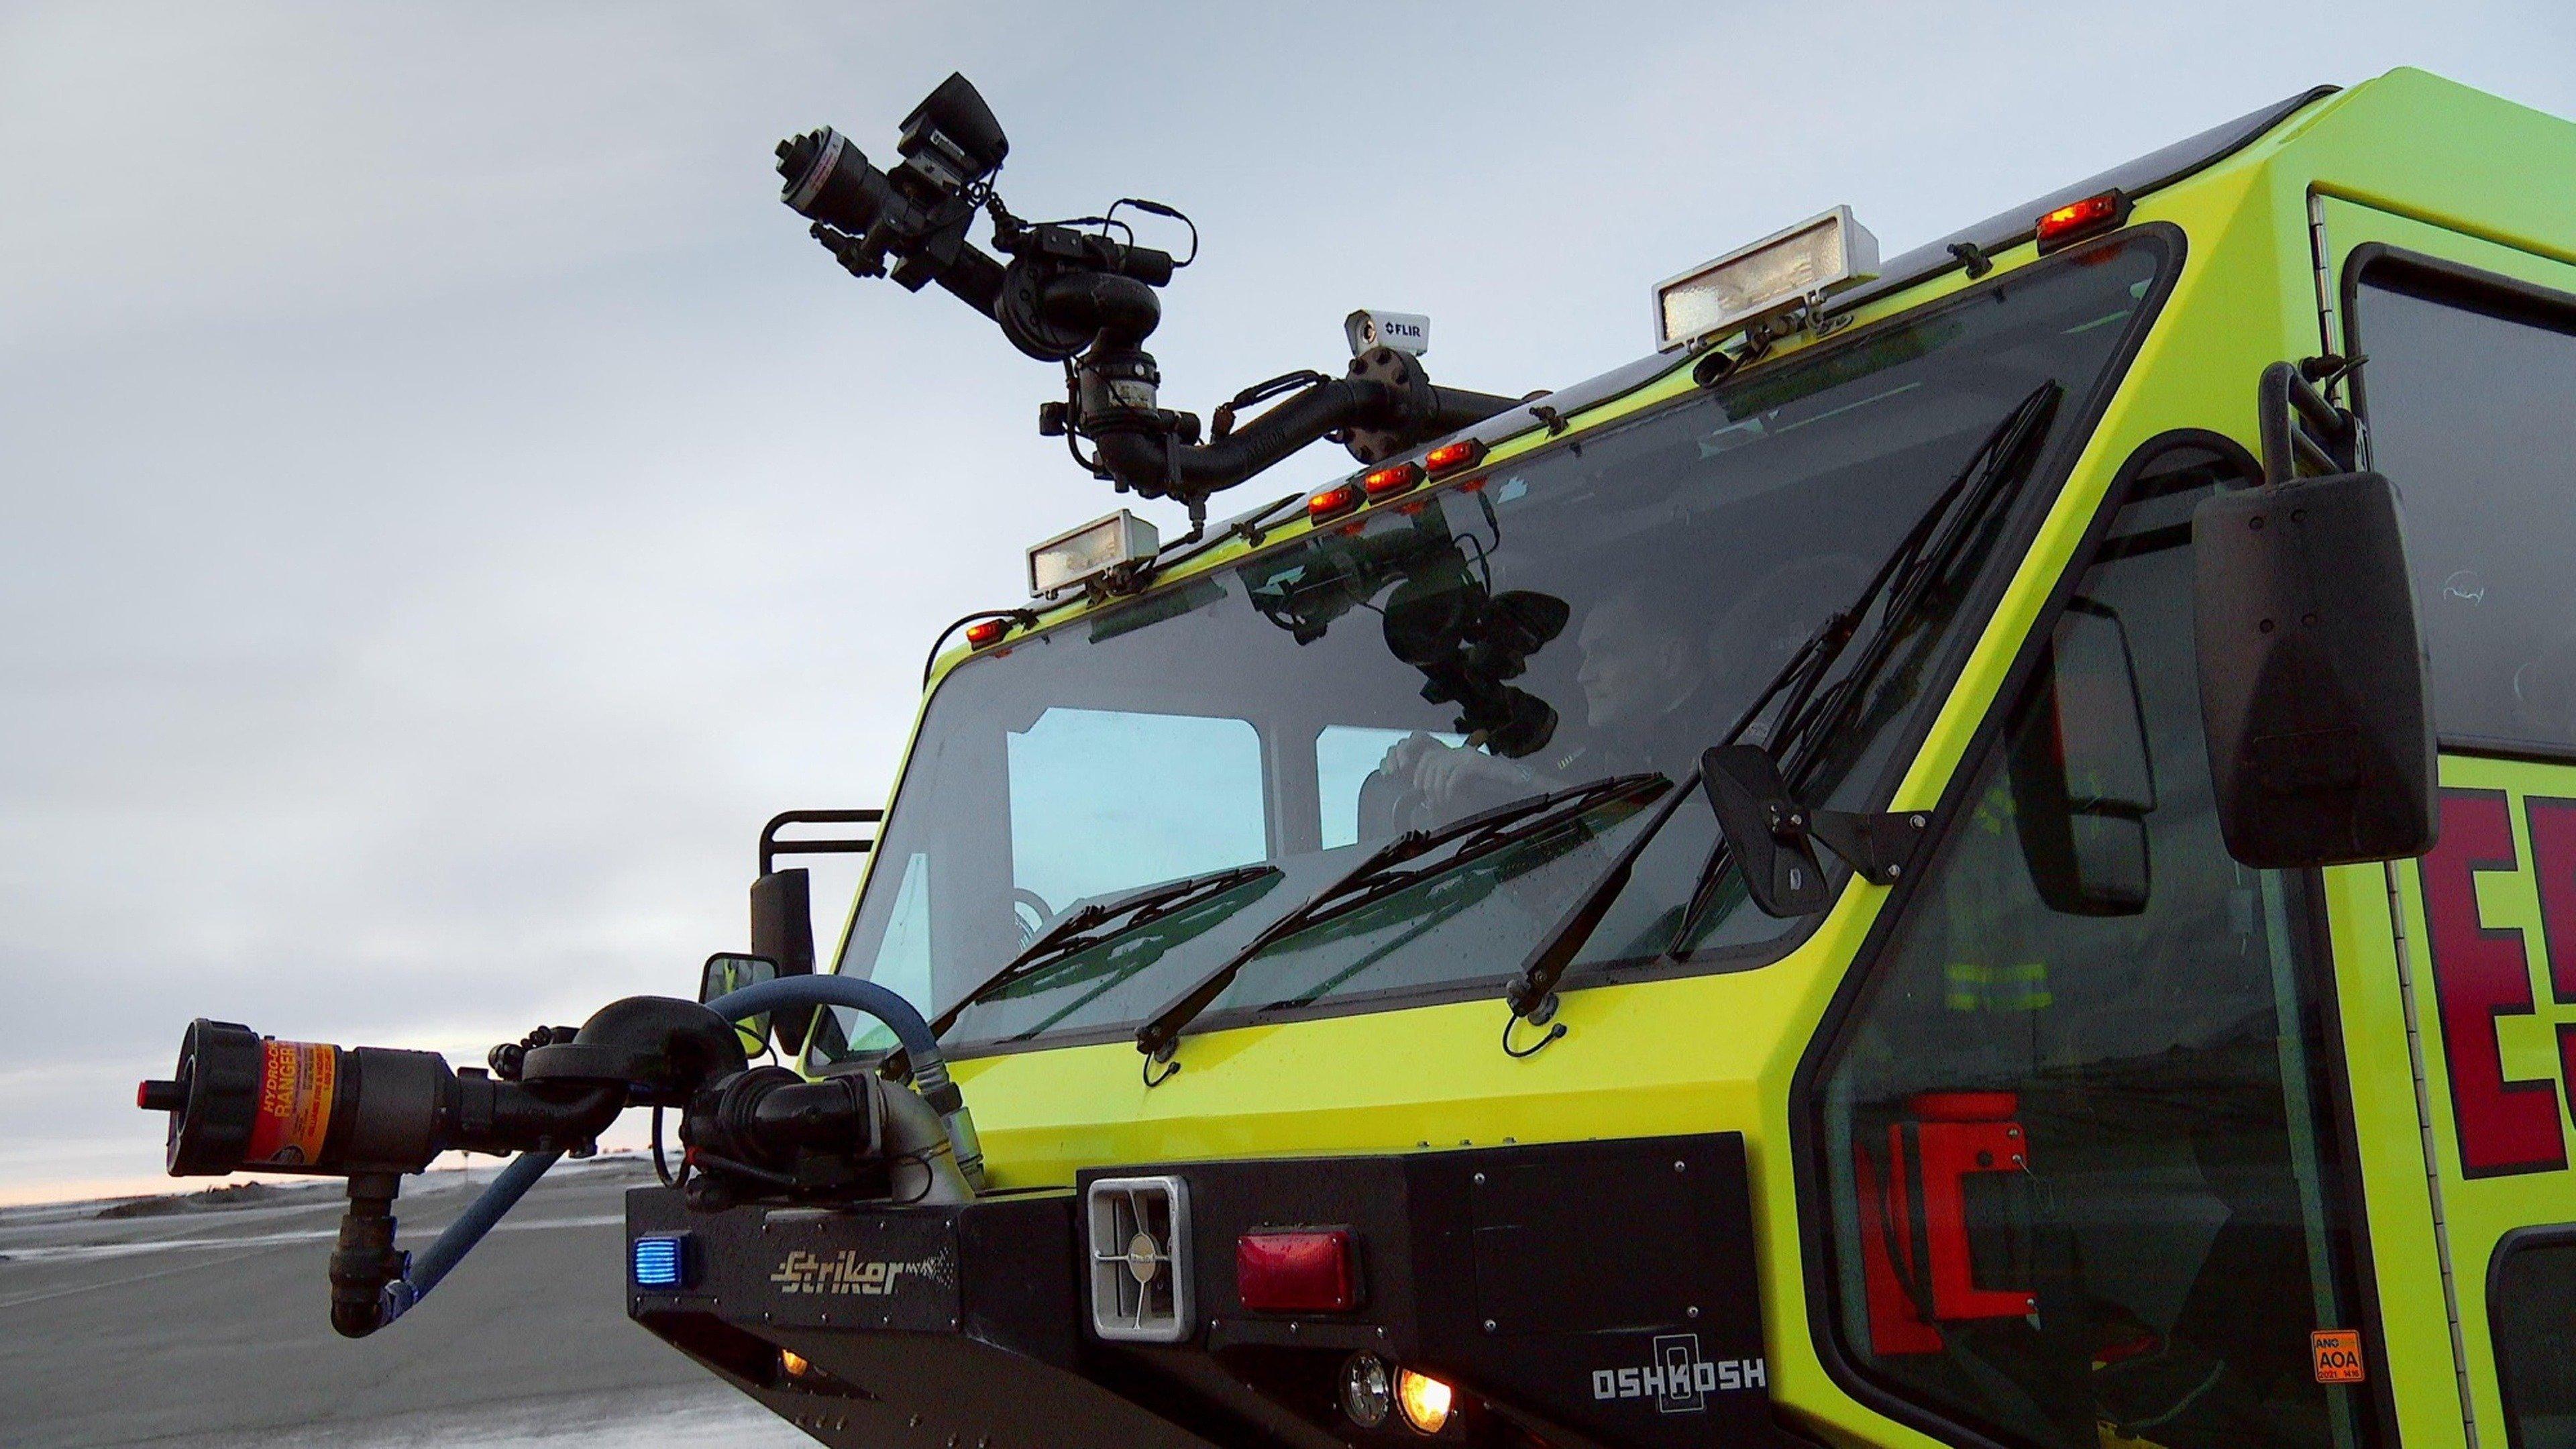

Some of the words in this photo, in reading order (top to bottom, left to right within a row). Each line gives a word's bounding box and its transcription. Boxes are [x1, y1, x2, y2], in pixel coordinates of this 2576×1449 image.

[1395, 323, 1420, 337] FLIR
[274, 1048, 296, 1118] RANGER
[771, 1250, 904, 1295] Striker
[1593, 1358, 1766, 1399] OSHKOSH
[2320, 1351, 2359, 1368] AOA
